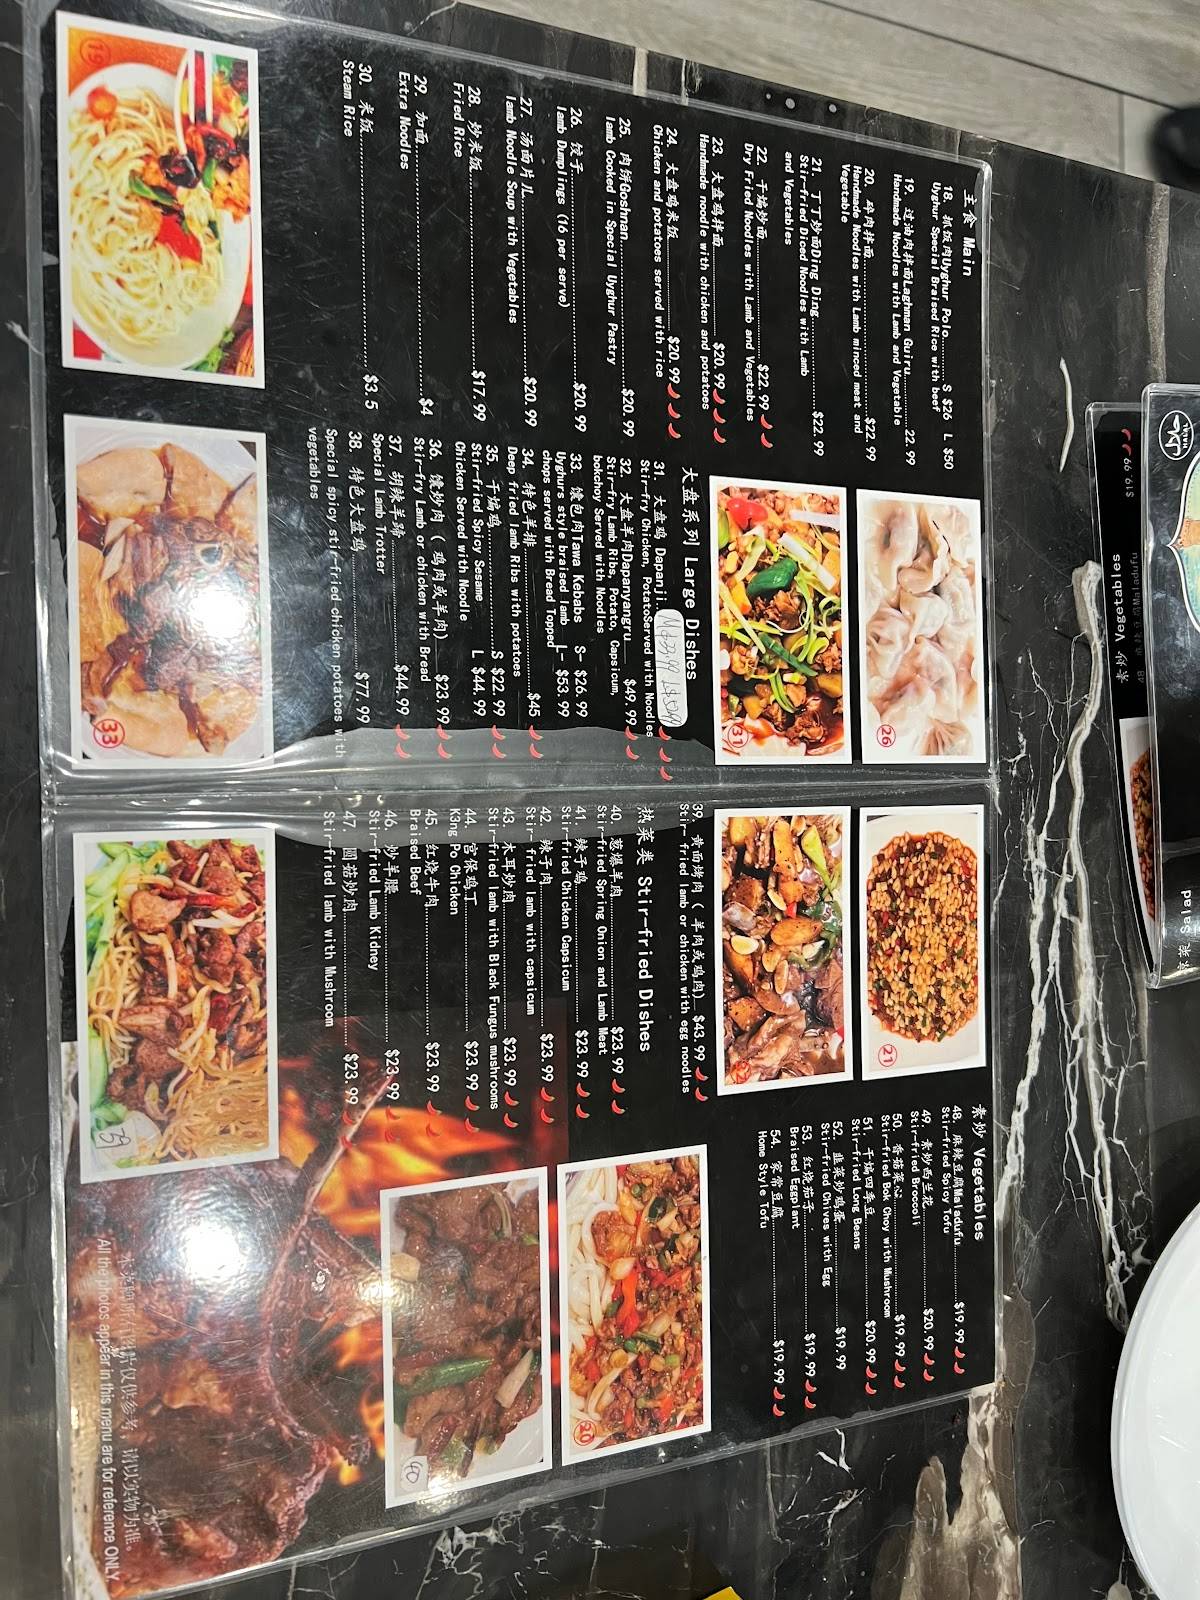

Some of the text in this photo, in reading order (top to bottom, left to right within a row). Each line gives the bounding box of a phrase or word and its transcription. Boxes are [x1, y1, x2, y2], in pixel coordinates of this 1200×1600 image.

[358, 63, 373, 85] 30.
[414, 74, 428, 96] 29.
[468, 85, 482, 107] 28.
[343, 59, 356, 137] Steam Rice
[399, 71, 412, 170] Extra Noodles
[453, 82, 466, 157] Fried Rice
[570, 106, 583, 128] 26.
[756, 145, 768, 166] 22.
[962, 236, 976, 276] Main
[743, 142, 756, 421] Dry Fried Noodles with Lamb and Vegetables
[930, 181, 942, 412] Uyghur Special Braised Rice with beef
[362, 374, 379, 410] $3.5
[418, 397, 434, 416] $4
[471, 370, 487, 421] $17.99
[573, 380, 587, 432] $20.99
[757, 363, 770, 410] $22.99
[348, 430, 363, 452] 38.
[388, 434, 403, 456] 37.
[485, 444, 499, 465] 35.
[522, 448, 535, 469] 34.
[639, 459, 651, 512] Stir-fry
[1122, 457, 1135, 498] $19.99
[371, 432, 387, 574] Special Lamb Trotter
[471, 442, 486, 601] Stir-fried Spicy Sesame
[455, 441, 471, 621] Chicken Served with Noodle
[641, 518, 652, 567] Chicken,
[506, 446, 522, 677] Deep fried lamb Ribs with potatoes
[682, 557, 699, 608] Large
[1110, 553, 1126, 642] Vegetables
[491, 650, 504, 659] S
[684, 618, 700, 680] Dishes
[393, 663, 410, 715] $44.99
[471, 649, 486, 716] L $44.99
[490, 667, 506, 717] $22.99
[644, 660, 654, 686] with
[354, 671, 371, 723] $77.99
[527, 691, 541, 717] $45
[645, 692, 656, 737] Noodles
[102, 722, 118, 745] 33
[732, 727, 744, 745] 31
[881, 727, 892, 745] 26
[384, 809, 398, 830] 46.
[425, 808, 438, 829] 45.
[464, 807, 477, 828] 44.
[610, 804, 622, 824] 40.
[410, 809, 422, 895] Braised Beef
[450, 843, 461, 858] Po
[368, 810, 381, 970] Stir-fried Lamb Kidney
[450, 864, 461, 915] Chicken
[1180, 890, 1192, 934] Salad
[595, 805, 609, 1055] Stir-fried Spring Onion and Lamb Meat
[638, 876, 654, 979] Stir-fried
[639, 988, 655, 1052] Dishes
[425, 1041, 440, 1092] $23.99
[464, 1040, 479, 1090] $23.99
[610, 1026, 625, 1074] $23.99
[883, 1046, 894, 1063] 21
[384, 1049, 400, 1100] $23.99
[770, 1129, 782, 1149] 54.
[802, 1125, 813, 1144] 53.
[892, 1113, 903, 1131] 50.
[921, 1109, 932, 1127] 49.
[757, 1130, 770, 1228] Home Style Tofu
[790, 1126, 801, 1229] Braised Eggplant
[910, 1110, 921, 1225] Stir-fried Broccoli
[881, 1114, 893, 1318] Stir-fried Bok Choy with Mushroom
[971, 1147, 987, 1240] Vegetables
[894, 1313, 906, 1357] $19.99
[923, 1307, 935, 1350] $20.99
[772, 1339, 785, 1384] $19.99
[804, 1334, 816, 1377] $19.99
[96, 1238, 118, 1583] All the photos appear in this menu are for reference ONLY.
[579, 1423, 593, 1443] 20
